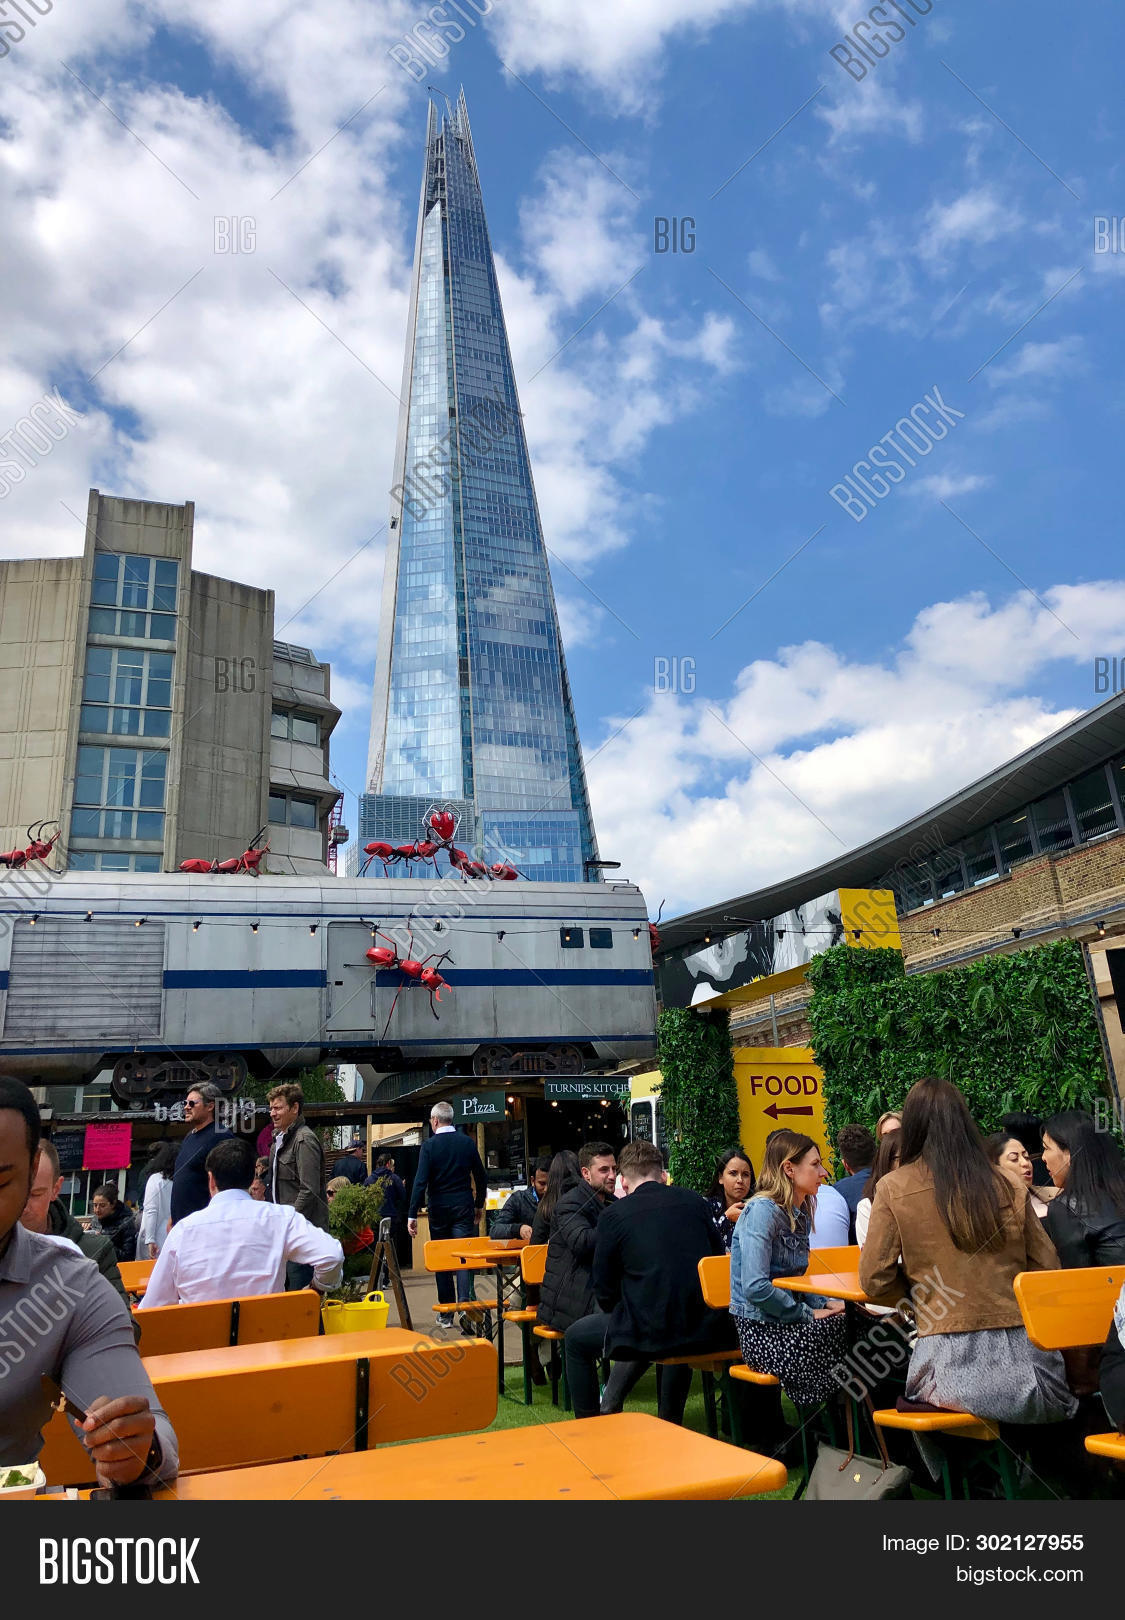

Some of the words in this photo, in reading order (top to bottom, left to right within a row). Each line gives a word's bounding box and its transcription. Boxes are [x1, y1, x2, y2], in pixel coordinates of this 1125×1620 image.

[547, 1083, 592, 1093] TURNIPS
[593, 1083, 630, 1093] KITCHE
[750, 1075, 818, 1096] FOOD
[461, 1097, 497, 1115] Pizza
